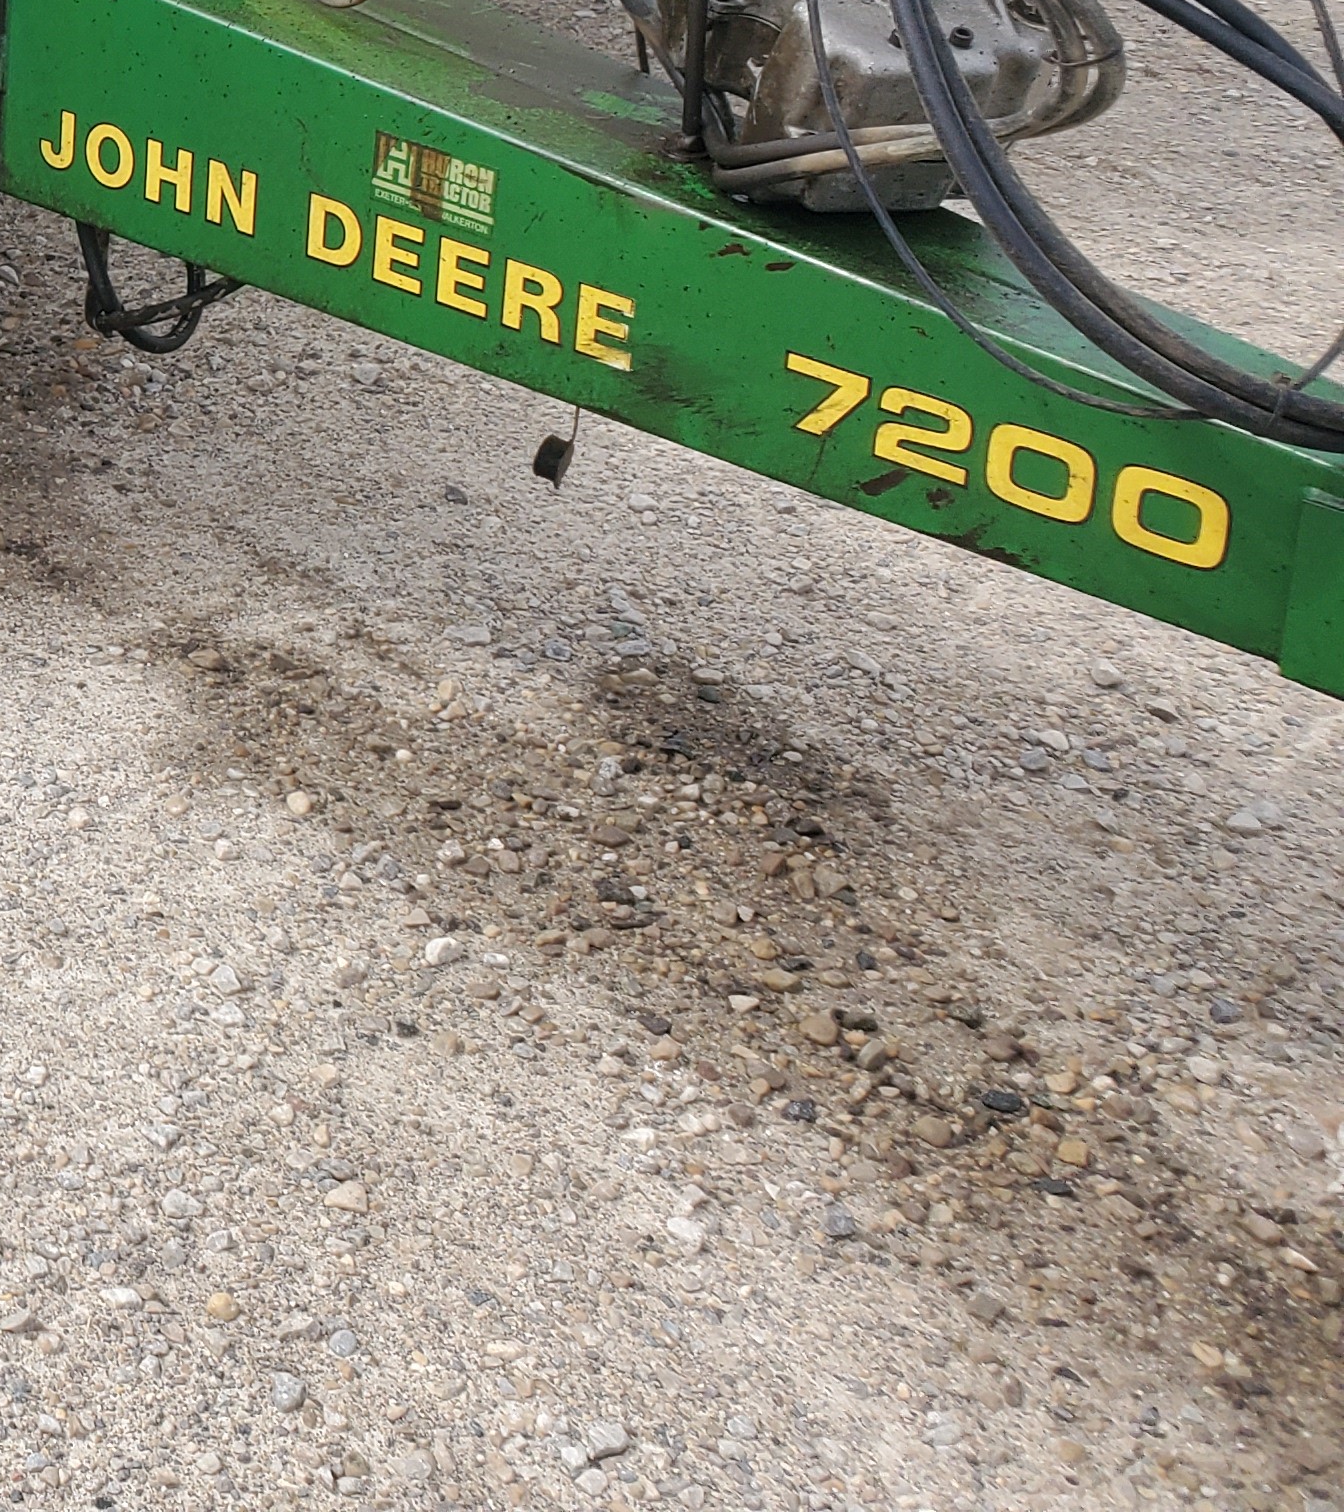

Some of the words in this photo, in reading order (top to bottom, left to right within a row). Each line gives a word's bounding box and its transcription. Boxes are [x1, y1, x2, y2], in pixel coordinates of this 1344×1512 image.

[39, 109, 258, 236] JOHN
[305, 191, 636, 373] DEERE
[785, 350, 1231, 571] 7200
